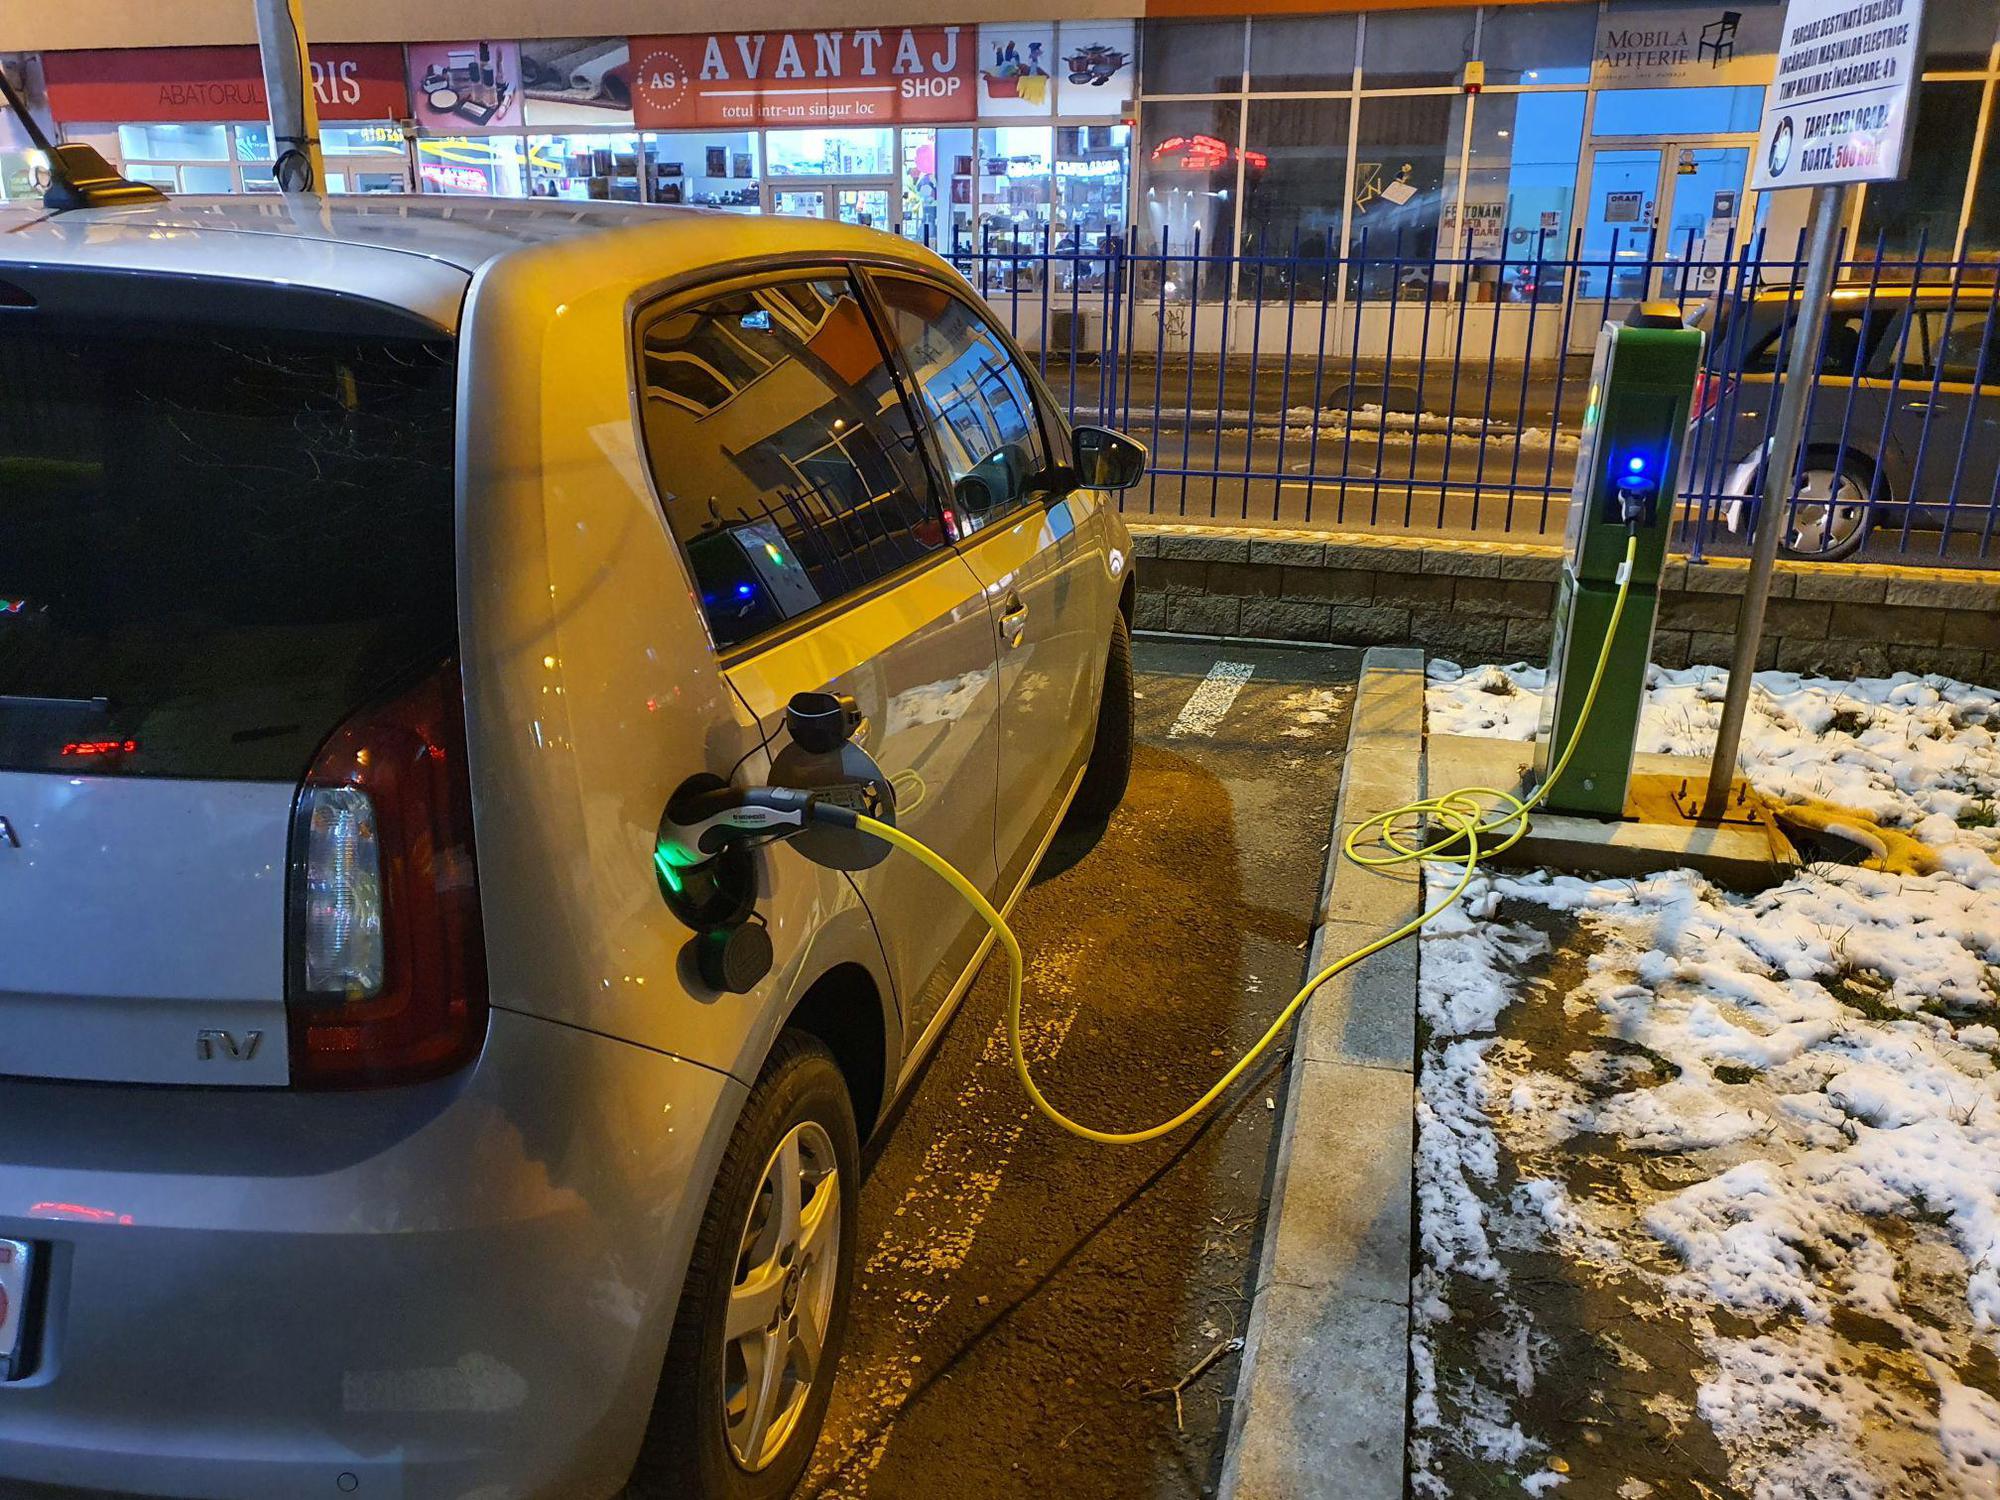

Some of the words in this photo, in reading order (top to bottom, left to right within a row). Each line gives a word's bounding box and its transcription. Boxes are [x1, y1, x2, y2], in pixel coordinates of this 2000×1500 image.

[1790, 20, 1821, 47] PARCARE
[1862, 0, 1905, 25] EXCLUSIV
[1862, 23, 1909, 54] ELECTRICE
[700, 27, 960, 80] AVANTAJ
[650, 72, 676, 89] AS
[901, 76, 960, 98] SHOP
[1780, 79, 1798, 100] TIMP
[1795, 74, 1822, 97] MAXIM
[1821, 71, 1833, 91] DE
[158, 84, 264, 105] ABATORUL
[722, 104, 753, 118] totul
[809, 102, 852, 119] singur
[855, 101, 875, 115] loc
[1804, 113, 1832, 139] TARIF
[1835, 144, 1857, 168] 500
